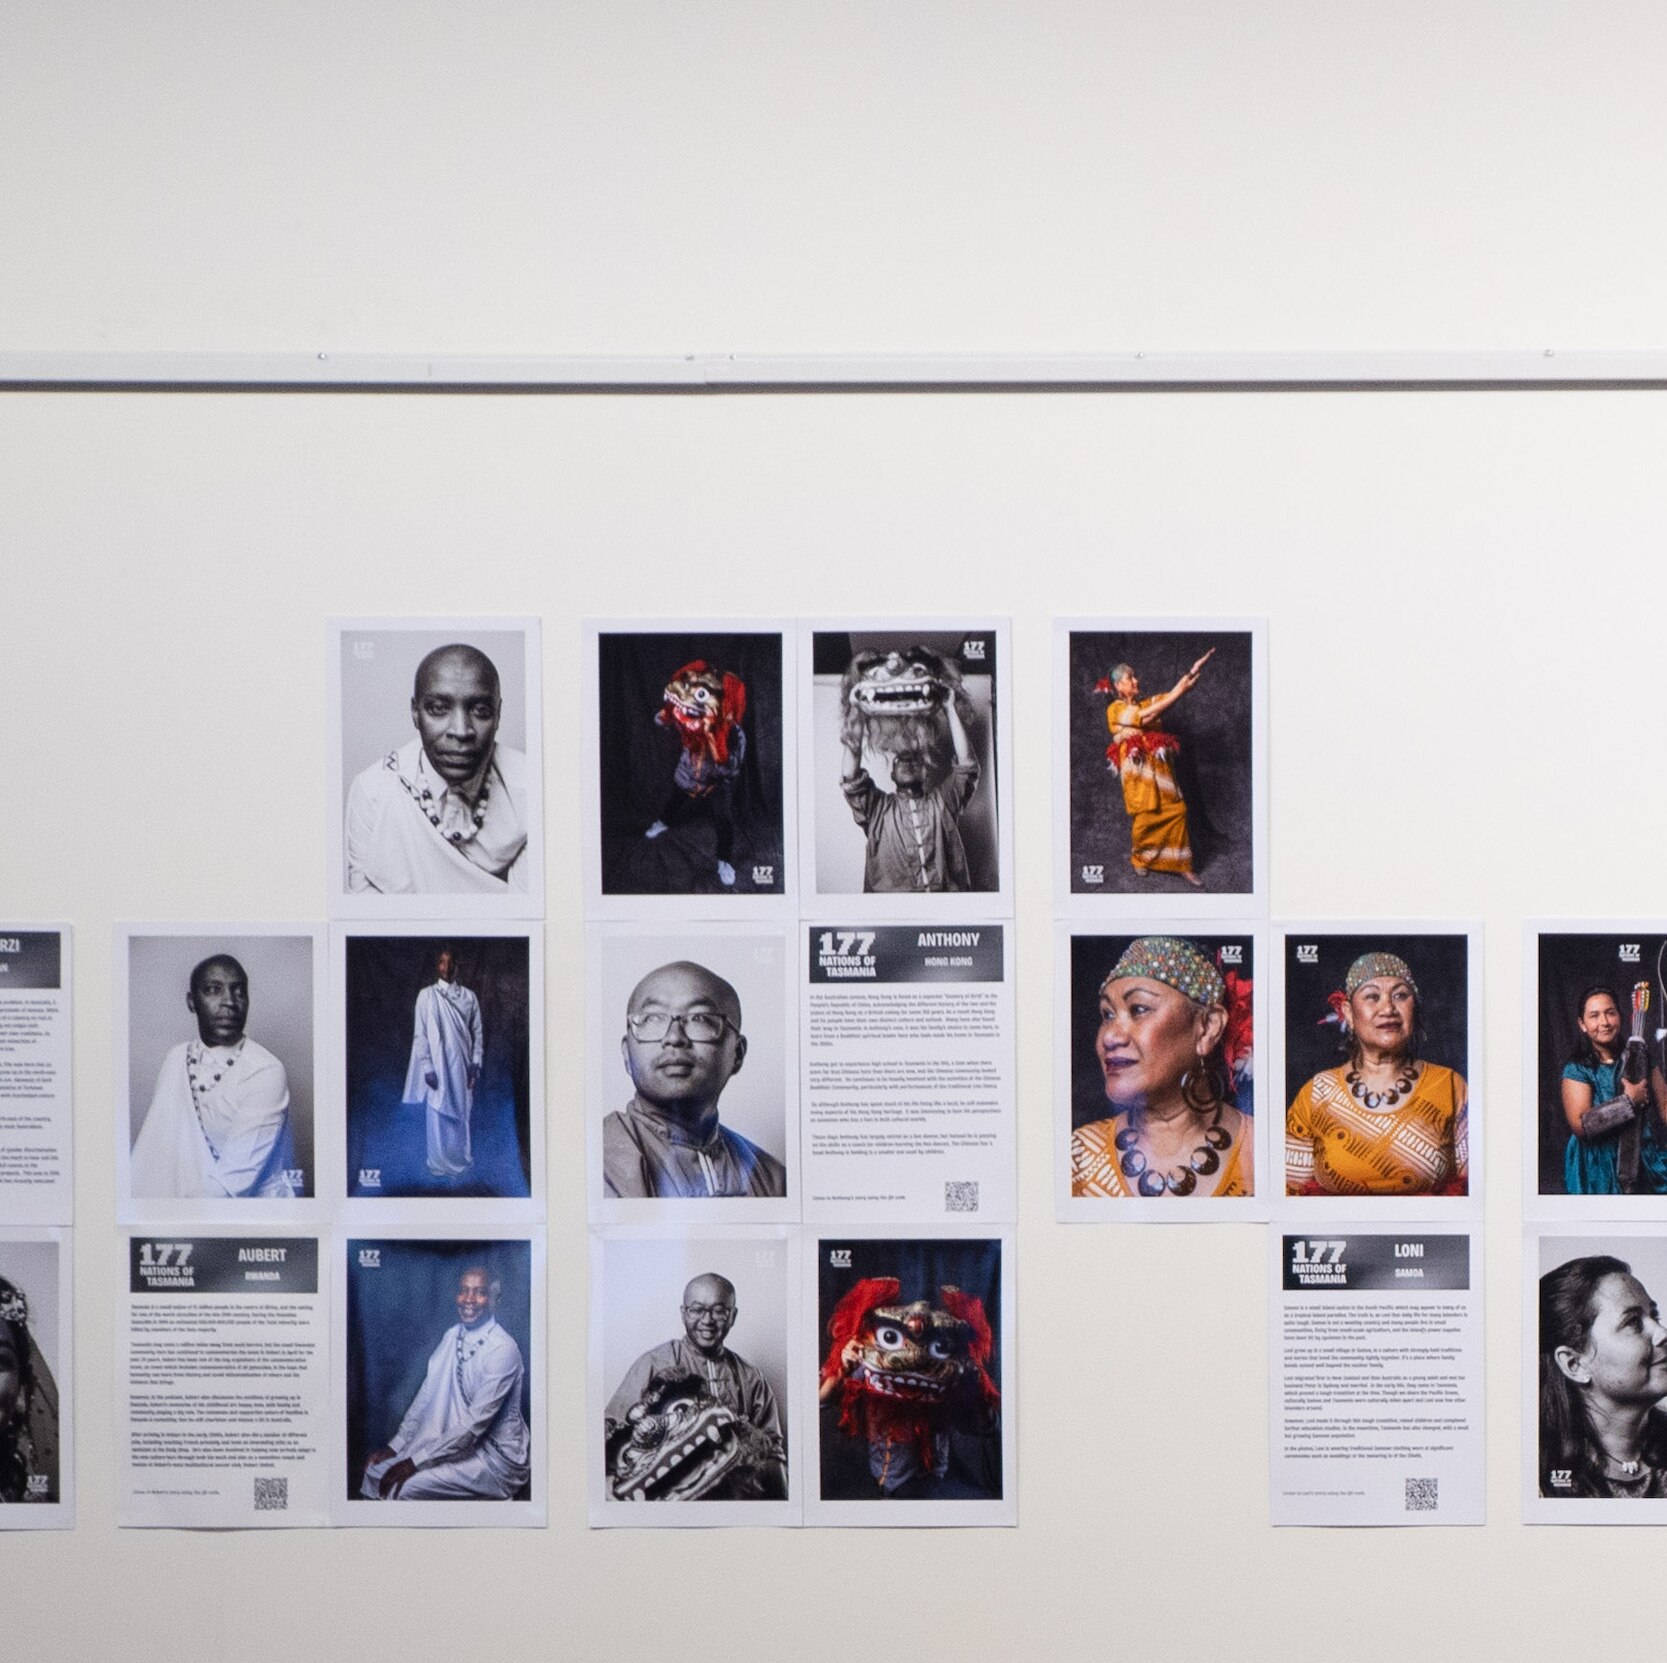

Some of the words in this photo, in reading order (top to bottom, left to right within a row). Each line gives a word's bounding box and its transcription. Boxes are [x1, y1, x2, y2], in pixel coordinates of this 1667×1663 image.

[964, 641, 985, 651] 177
[753, 866, 773, 876] 177
[1083, 866, 1104, 875] 177
[819, 931, 876, 956] 177
[918, 933, 980, 947] ANTHONY
[1221, 946, 1242, 955] 177
[1297, 945, 1318, 954] 177
[1619, 944, 1640, 953] 177
[819, 956, 862, 967] NATIONS
[863, 956, 876, 966] OF
[925, 957, 949, 967] HONG
[950, 957, 973, 967] KONG
[826, 966, 876, 978] TASMANIA
[359, 1170, 381, 1179] 177
[139, 1243, 193, 1266] 177
[238, 1248, 287, 1262] AUBERT
[359, 1250, 380, 1259] 177
[830, 1250, 852, 1259] 177
[1292, 1241, 1347, 1263] 177
[1395, 1244, 1424, 1258] LONI
[139, 1266, 181, 1276] NATIONS
[182, 1266, 195, 1275] OF
[1292, 1264, 1333, 1274] NATIONS
[1335, 1264, 1347, 1273] OF
[1395, 1268, 1424, 1278] SAMOA
[245, 1271, 281, 1281] RWANDA
[1299, 1274, 1347, 1284] TASMANIA
[147, 1276, 195, 1287] TASMANIA
[1551, 1470, 1572, 1479] 177
